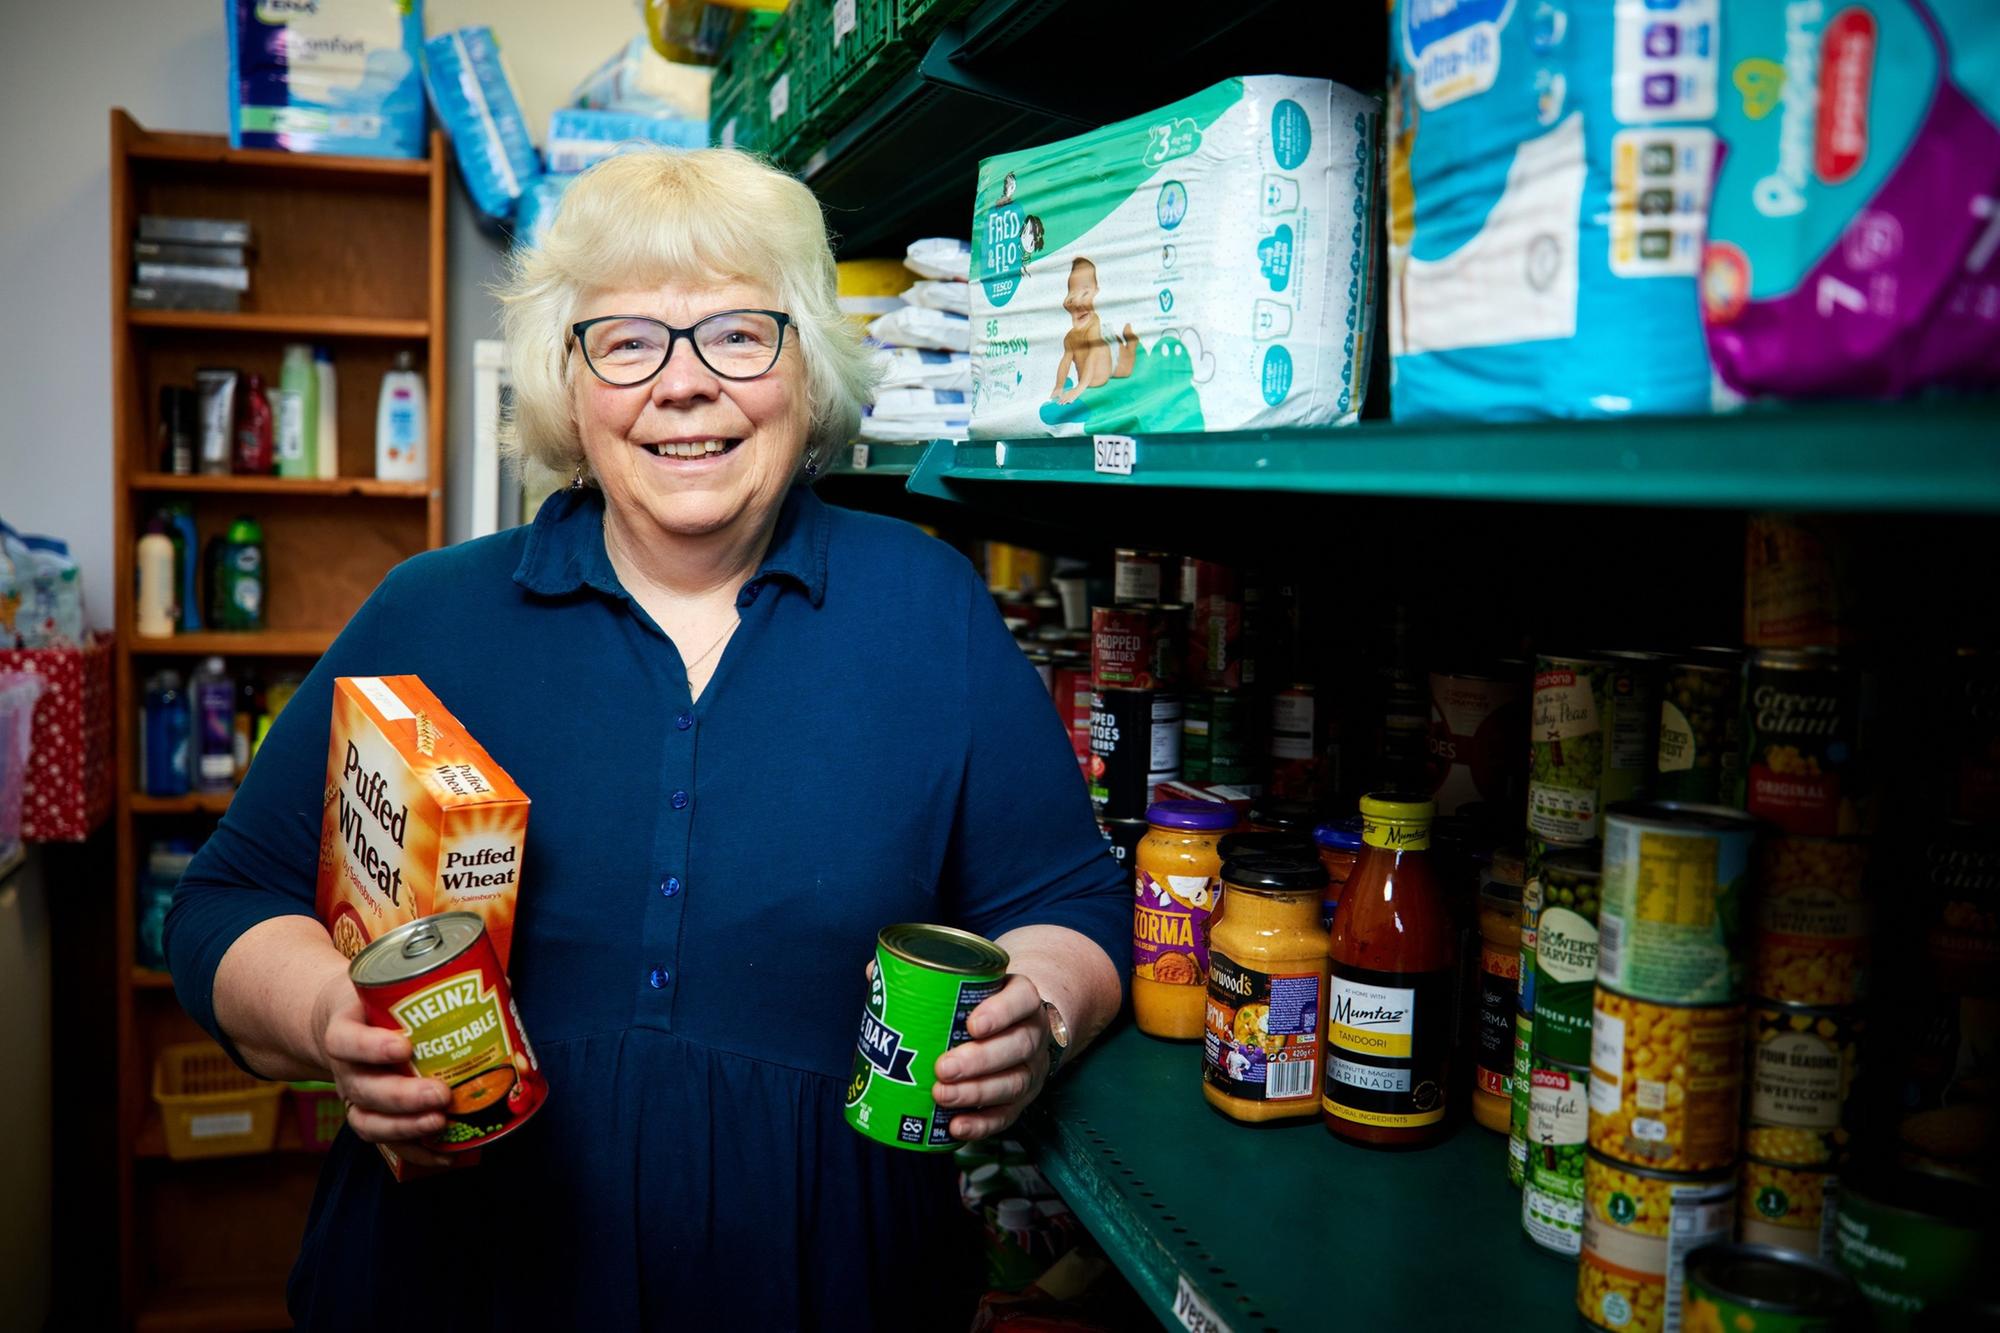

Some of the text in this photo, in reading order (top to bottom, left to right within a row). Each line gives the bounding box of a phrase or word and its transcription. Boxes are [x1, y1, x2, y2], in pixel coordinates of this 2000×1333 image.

[1154, 124, 1172, 162] 3
[988, 210, 1021, 245] FRED
[995, 242, 1017, 274] FLO
[992, 280, 1013, 293] TESCO
[986, 319, 998, 338] 56
[1097, 441, 1121, 467] SIZE
[1096, 633, 1141, 651] CHOPPED
[1754, 685, 1839, 713] Green
[436, 765, 468, 796] Wheat
[456, 764, 491, 795] Puffed
[343, 739, 409, 849] Puffed
[338, 788, 403, 908] Wheat
[445, 846, 516, 869] Puffed
[441, 867, 516, 891] Wheat
[349, 869, 384, 919] Sainsbury's
[461, 891, 502, 904] Sainsbury's
[404, 982, 476, 1029] HEINZ
[1352, 990, 1368, 999] HOME
[1332, 994, 1404, 1025] Mumtaz
[1569, 1015, 1593, 1030] PEA
[413, 1009, 498, 1061] VEGETABLE
[864, 1018, 895, 1057] OAK
[1338, 1030, 1387, 1048] TANDOORI
[450, 1045, 473, 1061] SOUP
[1338, 1061, 1365, 1075] MINUTE
[1367, 1069, 1396, 1079] MAGIC
[1332, 1105, 1358, 1119] NATURAL
[1358, 1112, 1409, 1124] INGREDIENTS
